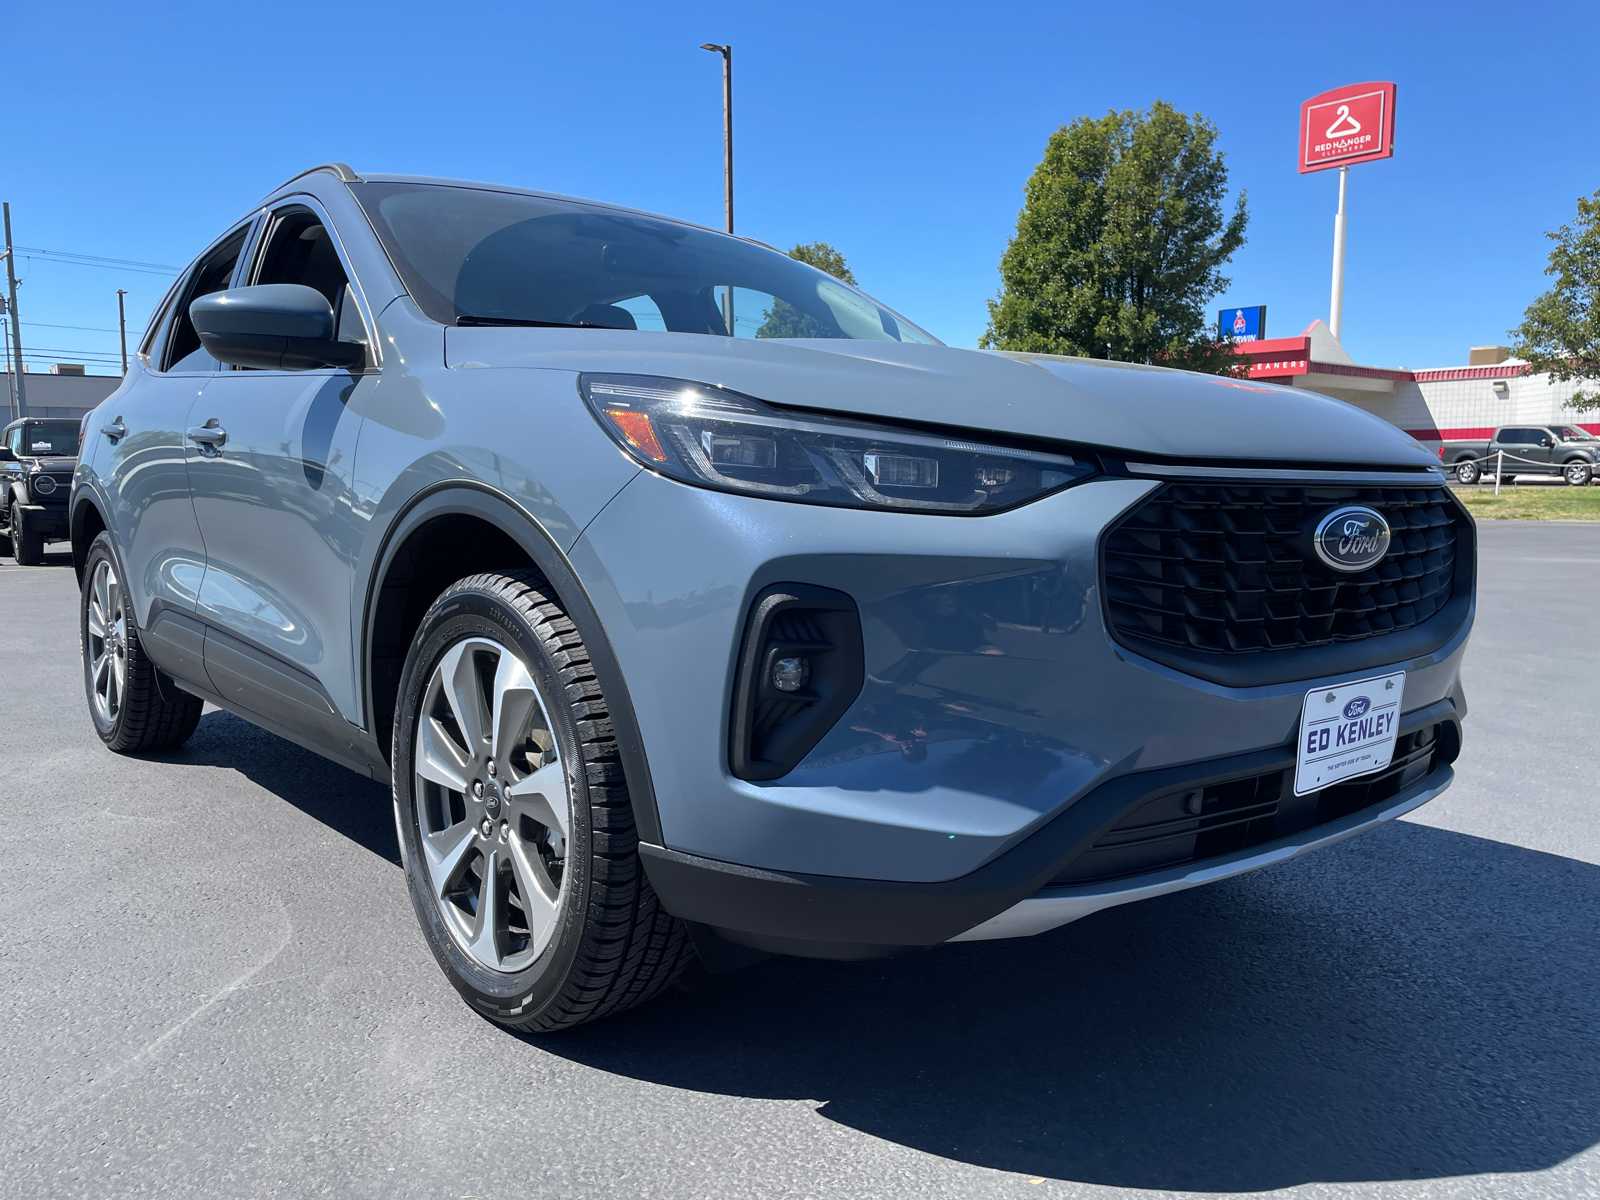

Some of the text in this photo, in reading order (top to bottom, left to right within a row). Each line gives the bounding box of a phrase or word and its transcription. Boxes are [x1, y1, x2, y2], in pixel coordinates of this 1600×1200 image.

[1315, 143, 1332, 153] RED
[1321, 144, 1363, 157] CLEANERS
[1338, 520, 1380, 555] Ford
[1307, 711, 1395, 754] ED KENLEY
